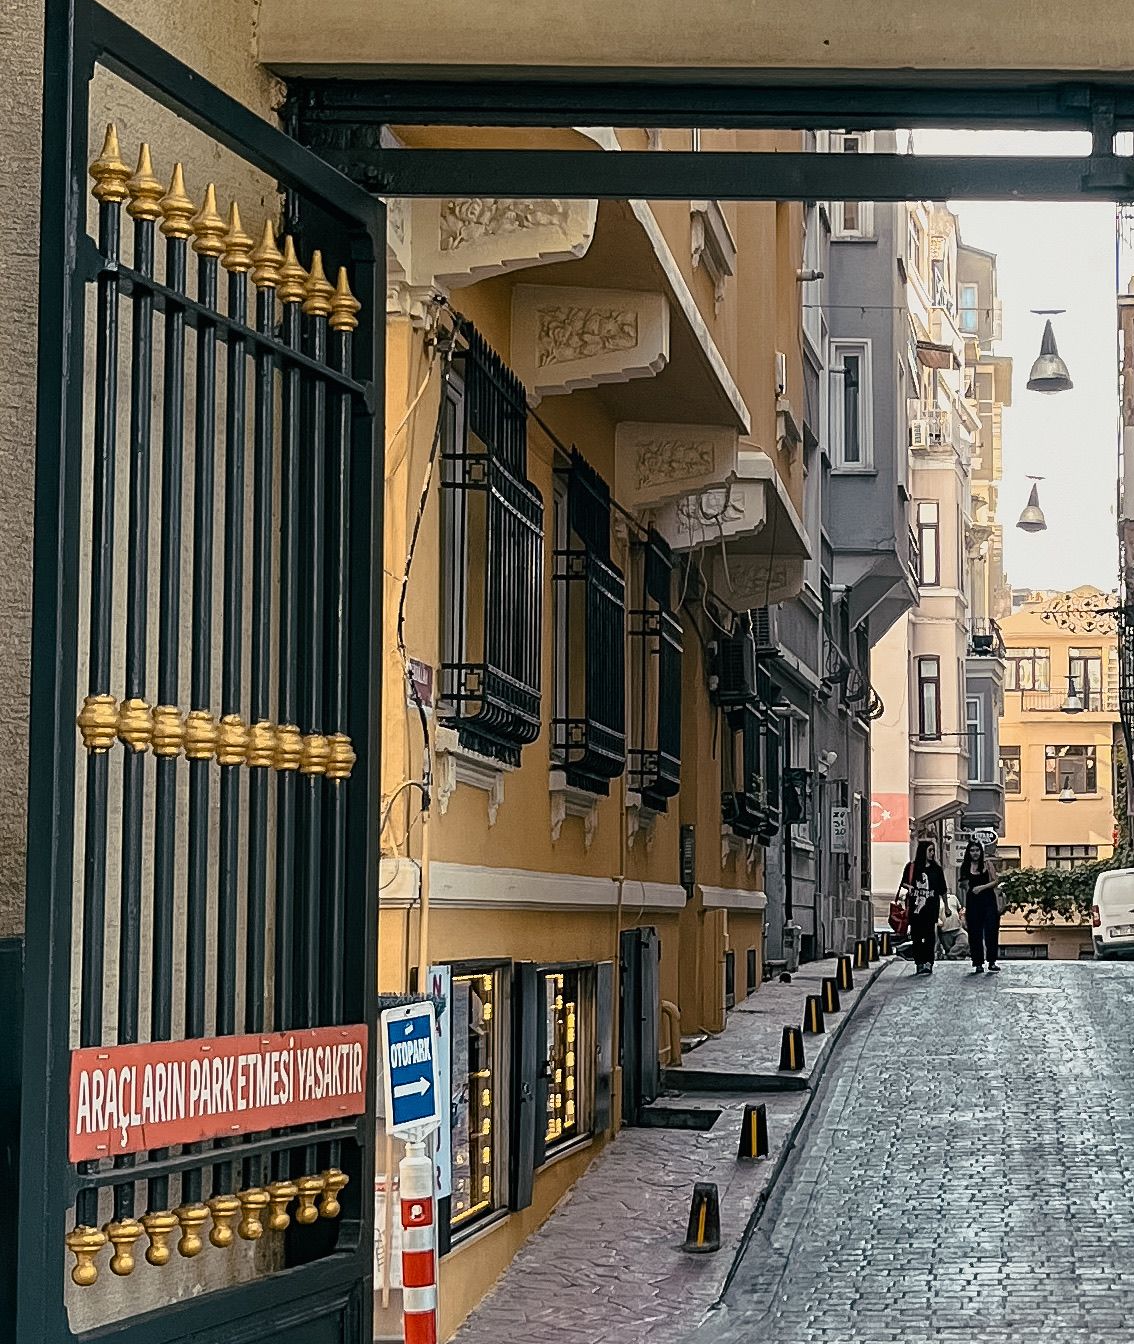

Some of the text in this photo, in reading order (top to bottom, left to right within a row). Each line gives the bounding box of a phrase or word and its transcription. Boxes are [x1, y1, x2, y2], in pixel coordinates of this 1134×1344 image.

[390, 1036, 431, 1069] OTOPARK
[76, 1036, 363, 1148] ARAÇLARIN PARK ETMESİ YASAKTIR
